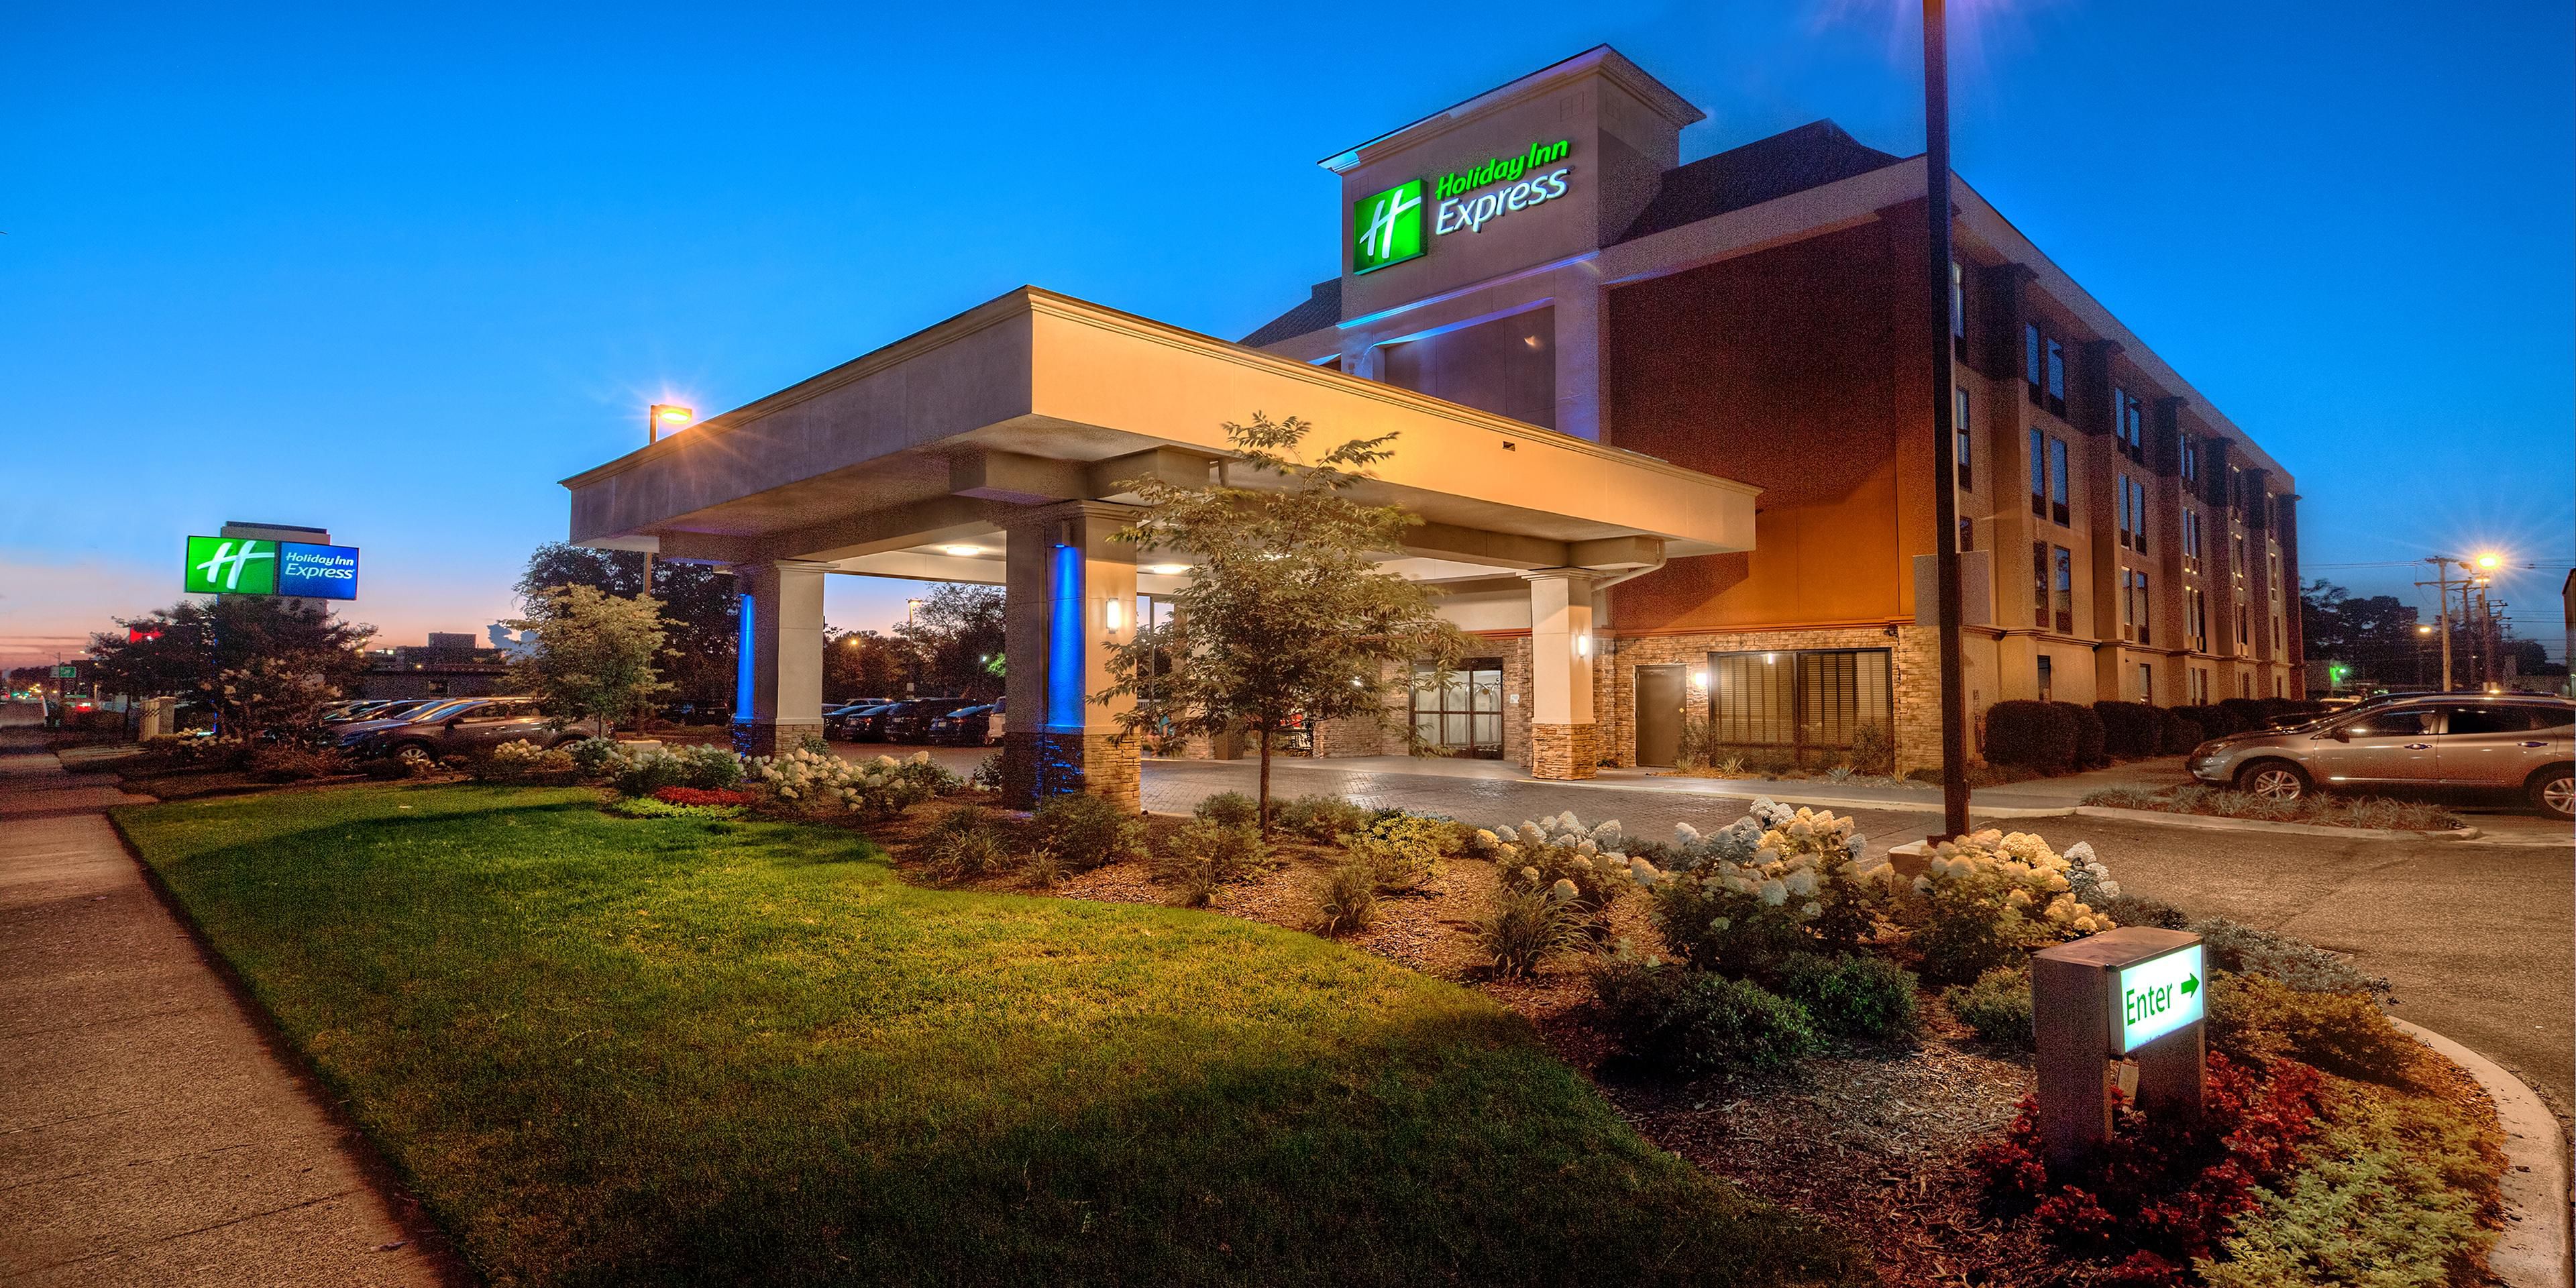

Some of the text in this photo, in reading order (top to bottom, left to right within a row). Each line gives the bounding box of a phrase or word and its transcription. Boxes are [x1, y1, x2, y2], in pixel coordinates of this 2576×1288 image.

[1435, 140, 1569, 200] Holiday Inn
[1436, 168, 1570, 235] Express
[285, 563, 354, 580] Express
[286, 552, 354, 566] Holiday Inn
[2126, 982, 2173, 1026] Enter
